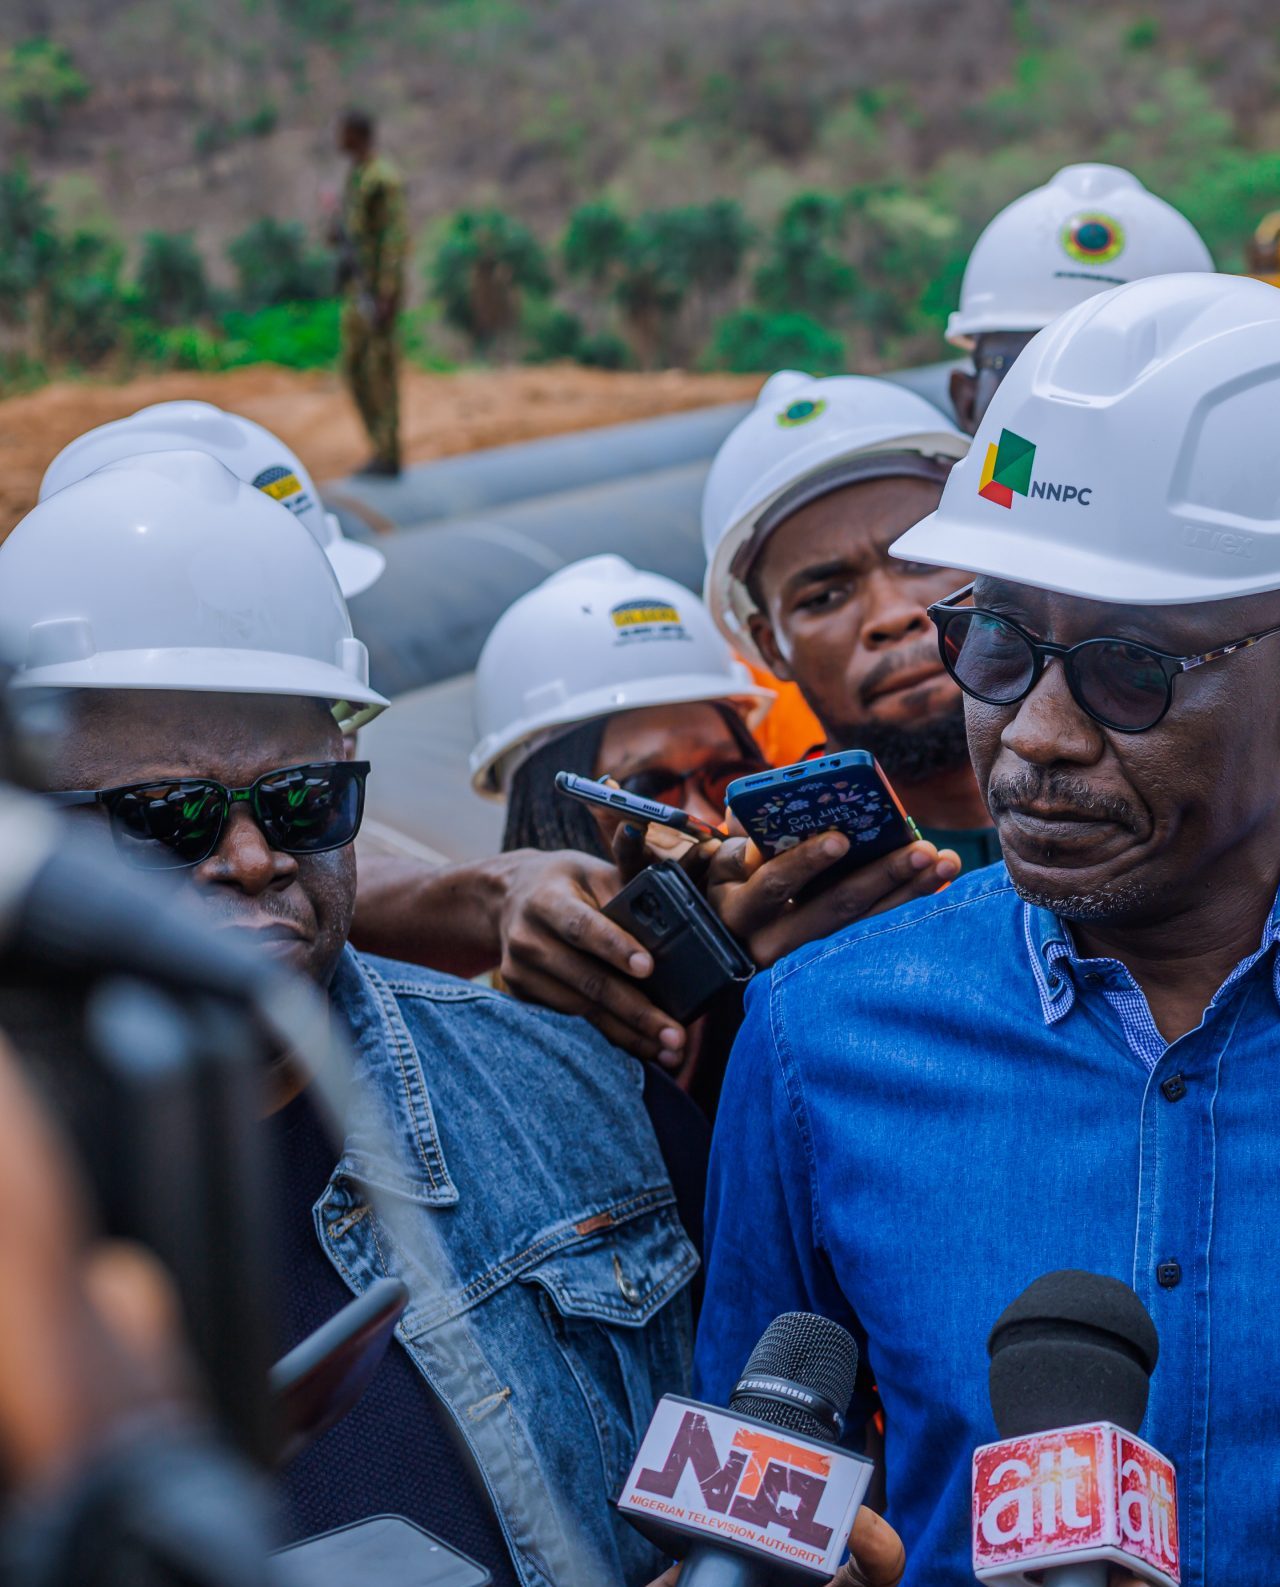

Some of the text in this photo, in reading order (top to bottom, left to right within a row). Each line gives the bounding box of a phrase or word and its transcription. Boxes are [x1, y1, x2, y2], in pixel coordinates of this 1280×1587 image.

[1031, 480, 1093, 506] NNPC
[787, 804, 849, 825] SHIT GO
[789, 810, 858, 833] LET THAT
[746, 1380, 814, 1404] SENNHEISER
[629, 1494, 826, 1566] NIGERIAN TELEVISION AUTHORITY
